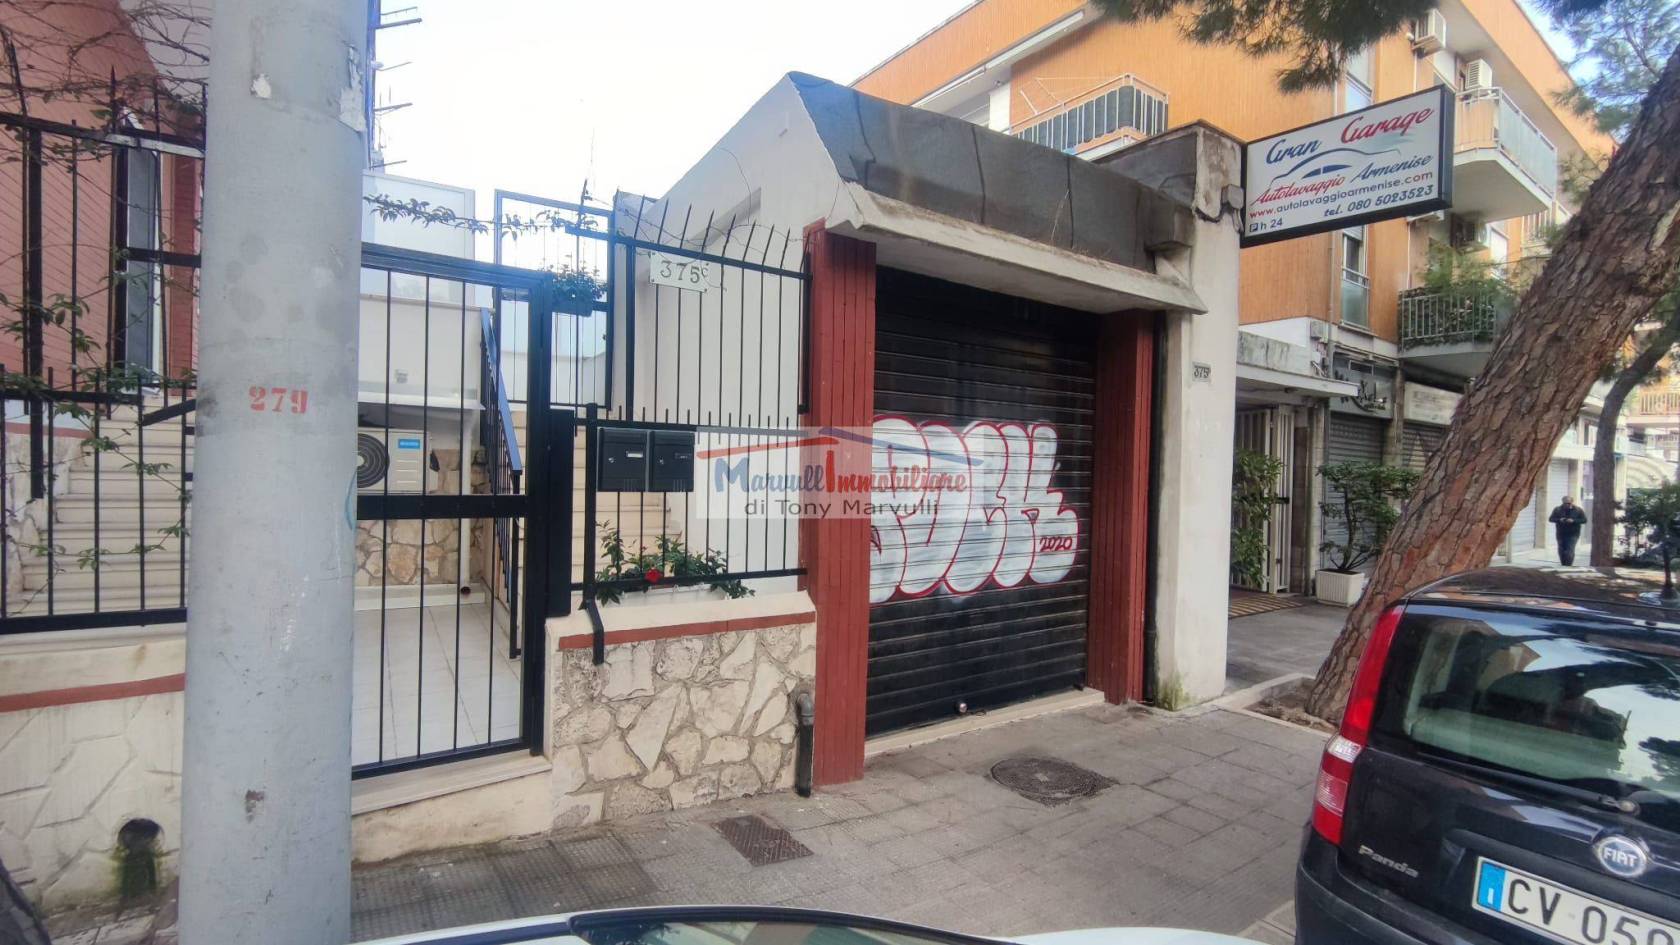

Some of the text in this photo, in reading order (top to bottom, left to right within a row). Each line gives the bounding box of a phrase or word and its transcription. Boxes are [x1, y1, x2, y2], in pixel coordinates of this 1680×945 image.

[1266, 107, 1435, 164] Gran Garage
[1249, 171, 1433, 219] www.autolavaggioarmenise.com
[1250, 153, 1434, 206] Autolavaggio Armenise
[1324, 184, 1433, 217] tel. 080 5023523
[1270, 217, 1283, 228] 24
[248, 386, 308, 414] 279
[1040, 535, 1073, 553] 2020
[1358, 844, 1419, 878] Panda
[1603, 847, 1638, 867] FIAT
[1508, 879, 1562, 925] CV
